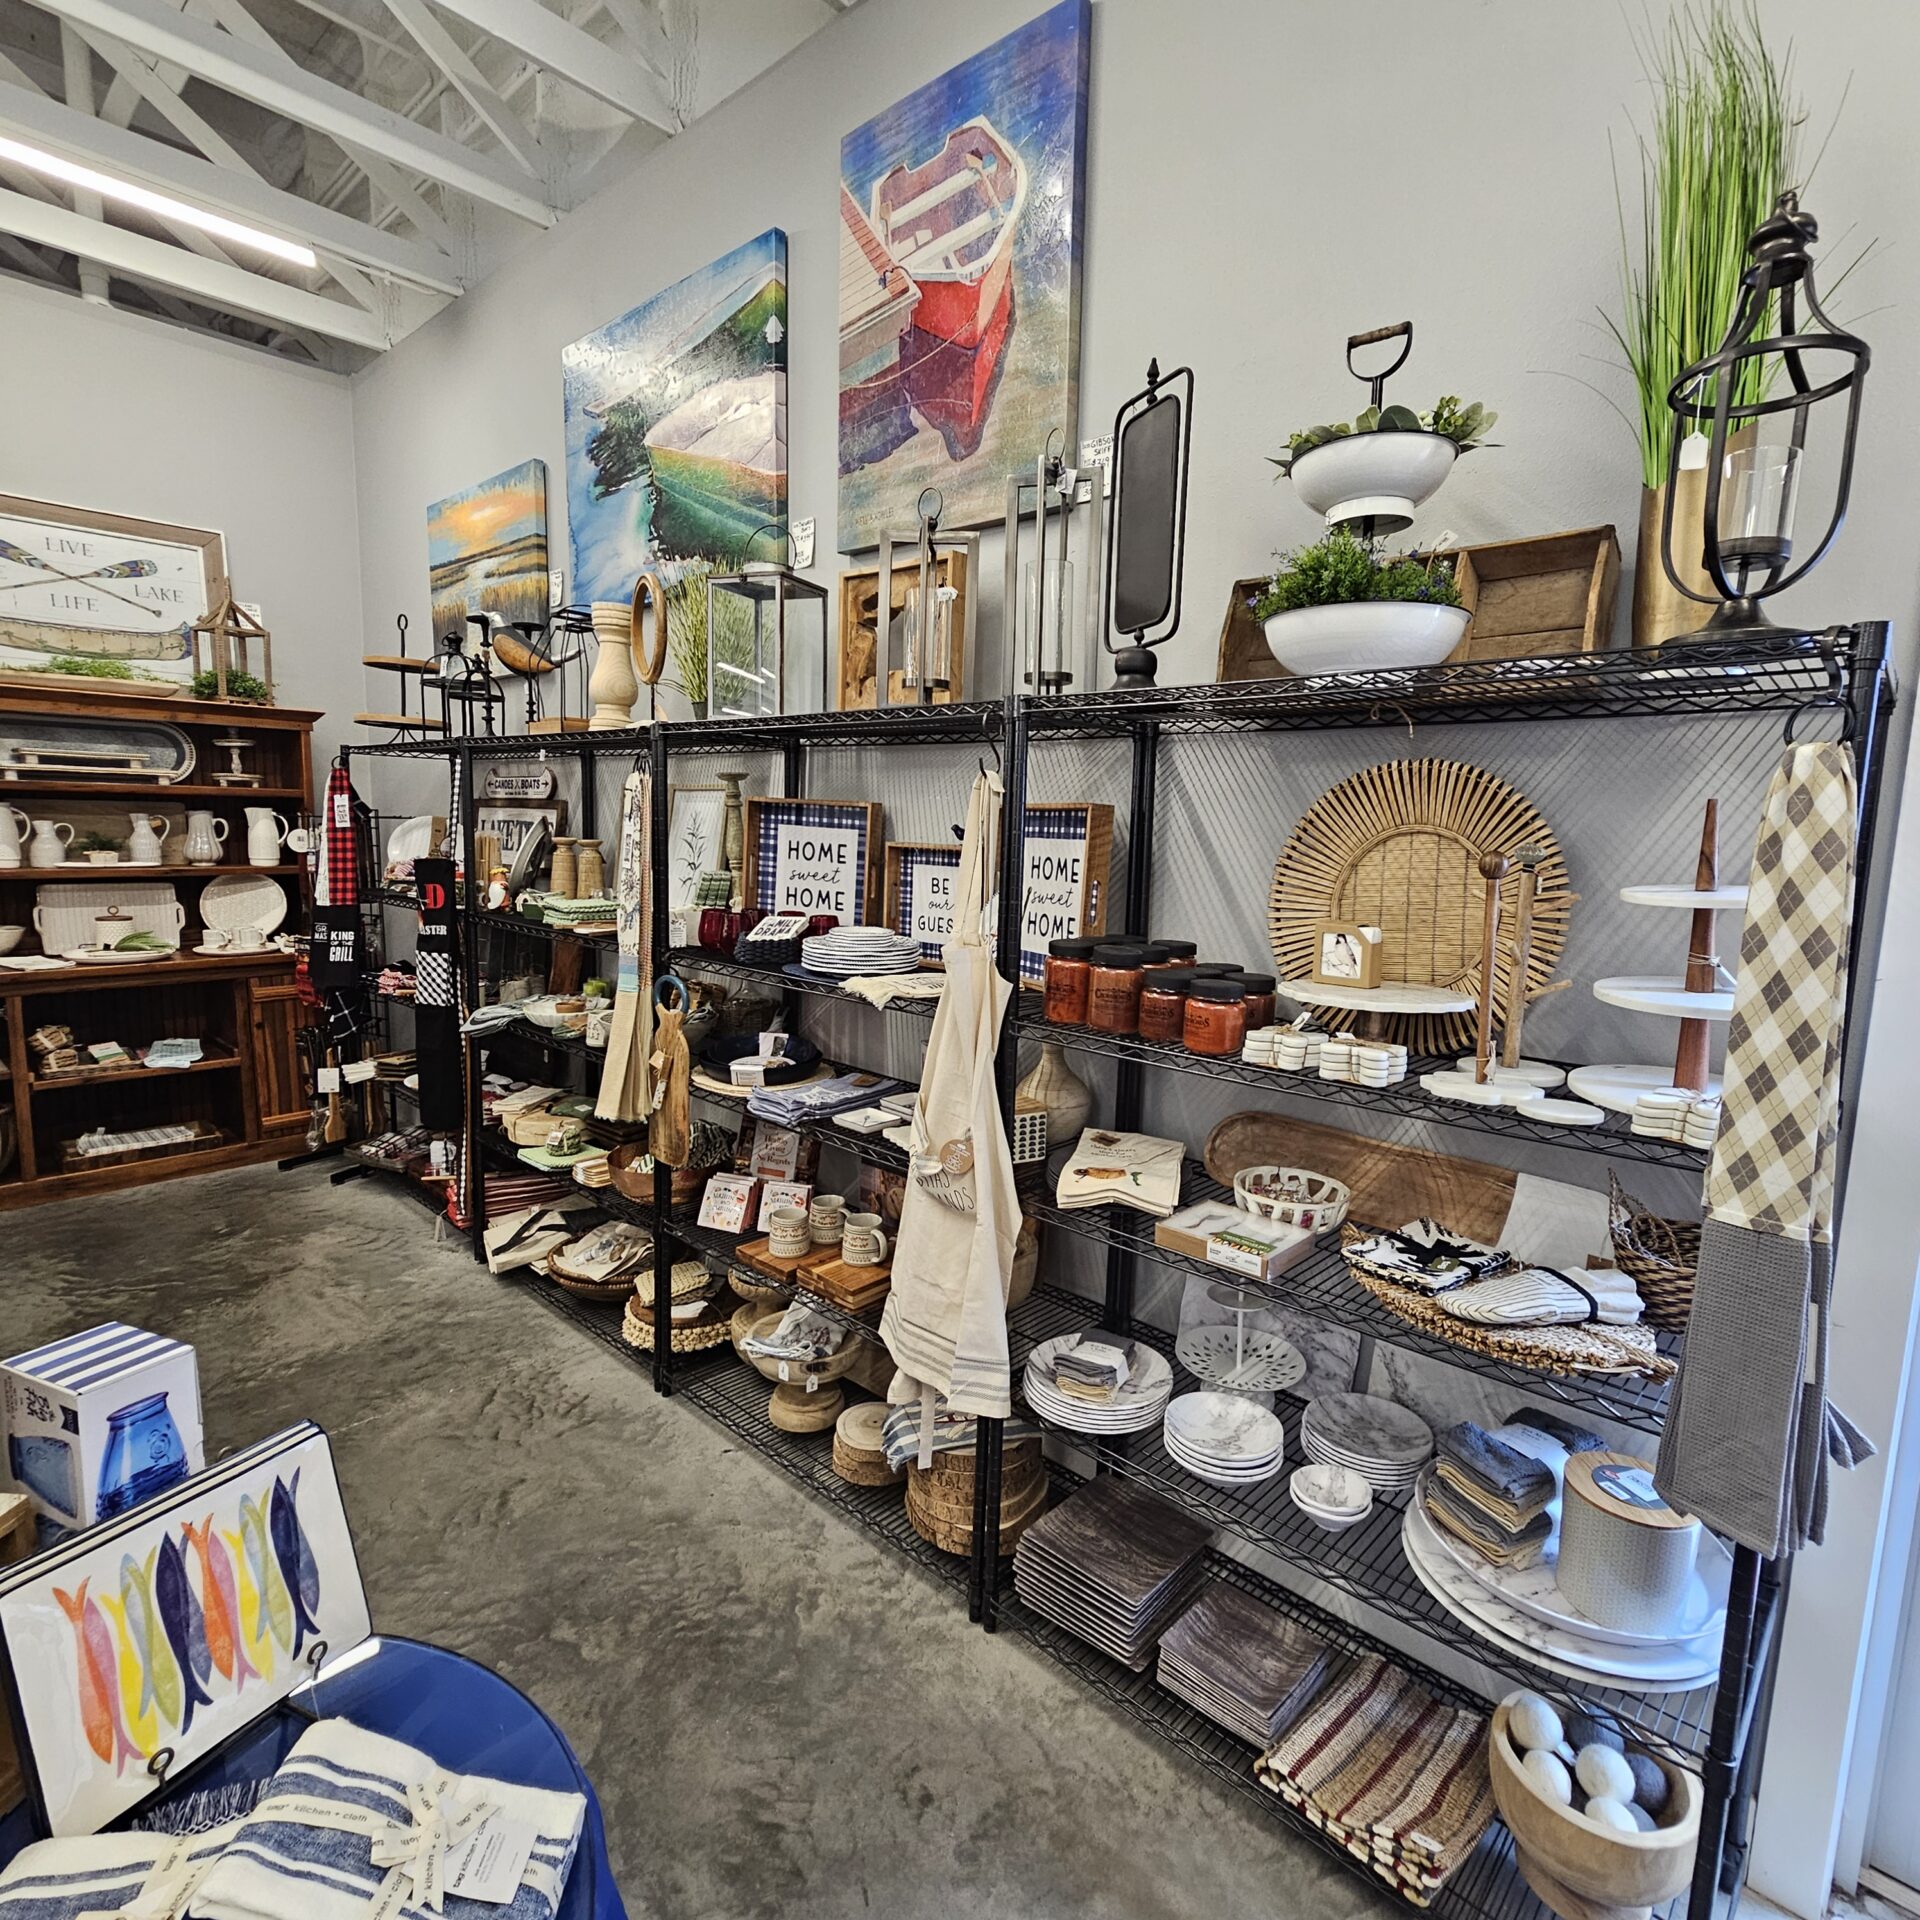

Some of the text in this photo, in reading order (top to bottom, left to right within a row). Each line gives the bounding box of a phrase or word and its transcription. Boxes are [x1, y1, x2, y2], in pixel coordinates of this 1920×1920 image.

[45, 536, 94, 557] LIVE
[50, 593, 99, 612] LIFE
[134, 584, 184, 604] LAKE
[494, 779, 541, 790] CANOES BOATS
[788, 839, 847, 864] HOME
[789, 866, 841, 884] sweet
[1030, 855, 1080, 884] HOME
[931, 877, 950, 895] BE
[786, 886, 845, 911] HOME
[928, 899, 955, 910] our
[1031, 888, 1073, 908] sweet
[754, 927, 792, 937] DRAMA
[917, 915, 954, 934] GUES
[1027, 911, 1076, 940] HOME
[330, 931, 355, 941] KING
[329, 946, 355, 962] GRILL
[293, 1802, 332, 1816] kitchen
[342, 1811, 369, 1823] cloth
[423, 1853, 435, 1891] kitchen
[452, 1871, 466, 1889] tag
[462, 1843, 478, 1872] kitchen
